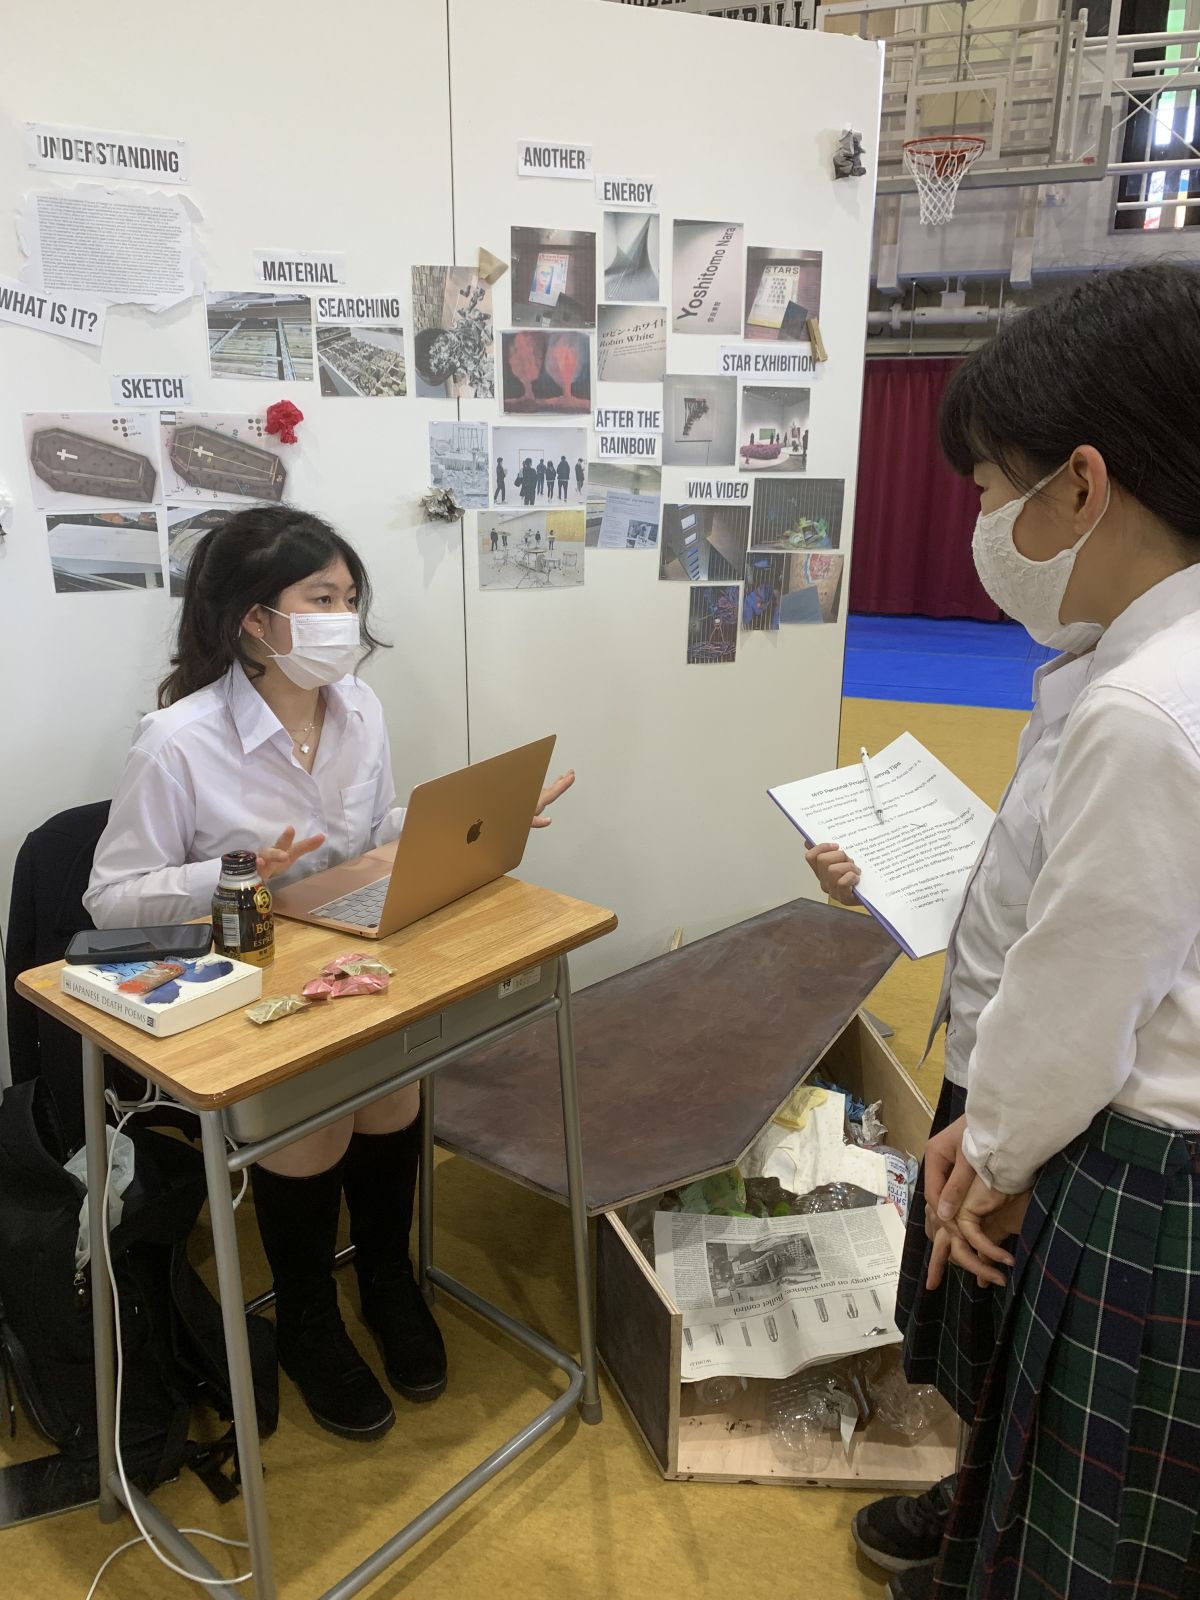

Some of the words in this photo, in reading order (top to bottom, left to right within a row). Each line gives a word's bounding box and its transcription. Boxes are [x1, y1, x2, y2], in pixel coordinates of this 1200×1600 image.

[37, 134, 180, 174] UNDERSTANDING
[524, 147, 585, 169] ANOTHER
[604, 182, 653, 202] ENERGY
[263, 261, 338, 283] MATERIAL
[676, 249, 726, 320] Yoshitomo
[715, 227, 736, 247] Nara
[765, 266, 800, 275] STARS
[0, 287, 47, 319] WHAT
[50, 302, 67, 325] IS
[71, 307, 98, 332] IT?
[319, 298, 399, 318] SEARCHING
[600, 338, 624, 348] Robin
[627, 332, 655, 342] White
[723, 354, 751, 371] STAR
[754, 354, 817, 373] EXHIBITION
[122, 379, 183, 398] SKETCH
[596, 410, 633, 428] AFTER
[638, 411, 660, 428] THE
[601, 437, 656, 455] RAINBOW
[689, 482, 712, 498] VIVA
[716, 481, 748, 499] VIDEO
[72, 983, 100, 1003] JAPANESE
[101, 996, 123, 1012] DEATH
[124, 1006, 146, 1023] POEMS
[784, 1285, 818, 1294] violence:
[821, 1281, 836, 1289] gun
[851, 1276, 881, 1286] strategy
[733, 1303, 761, 1315] control
